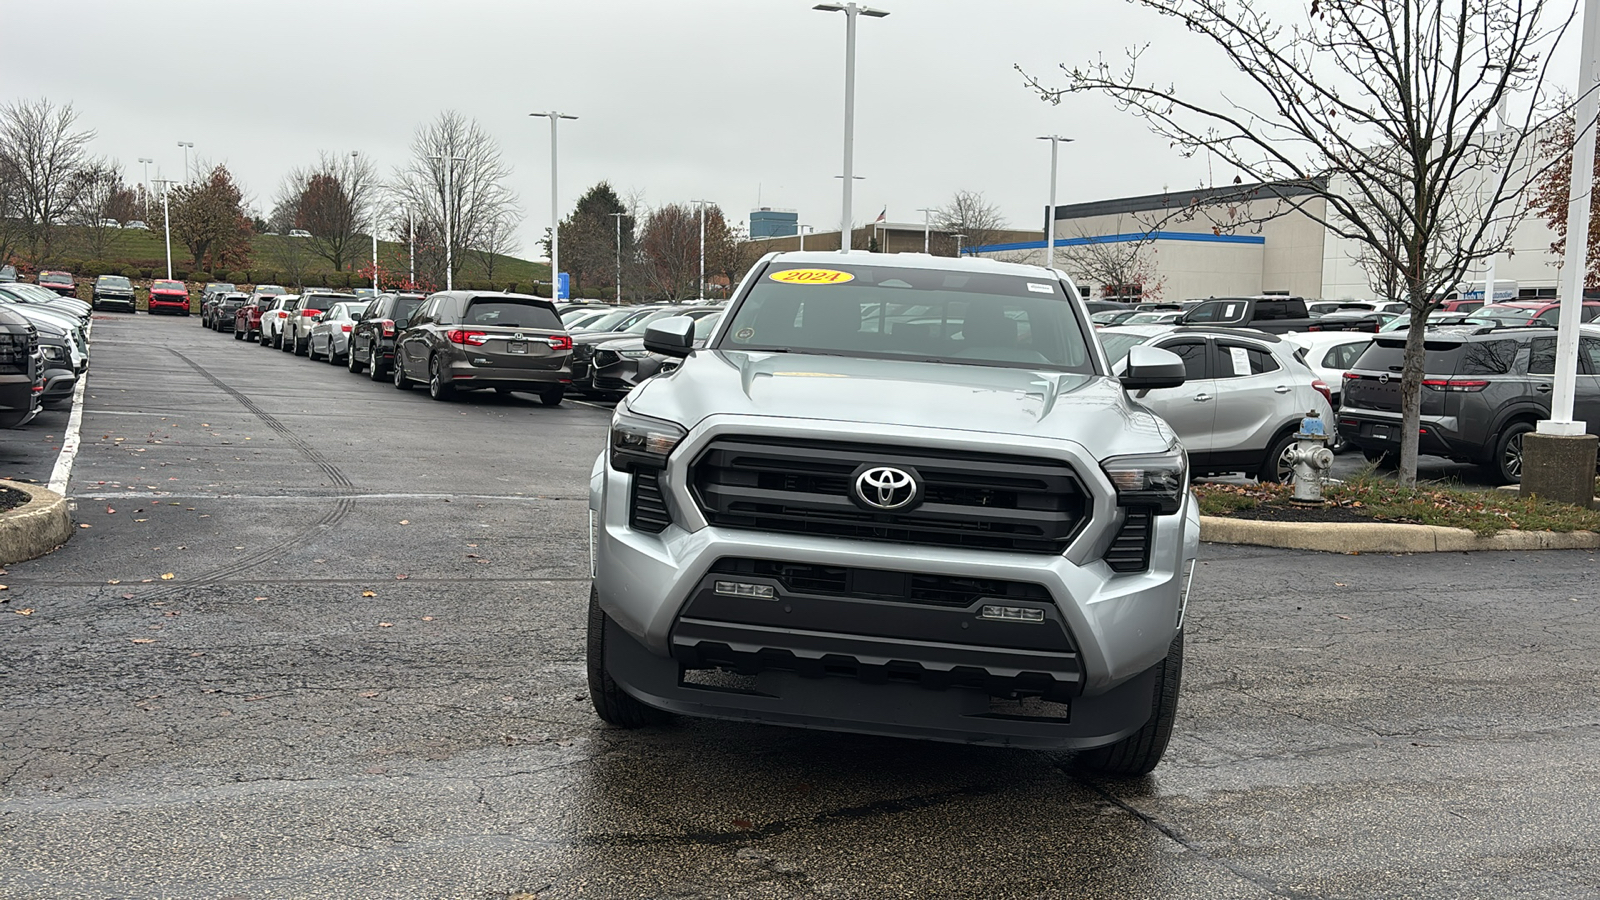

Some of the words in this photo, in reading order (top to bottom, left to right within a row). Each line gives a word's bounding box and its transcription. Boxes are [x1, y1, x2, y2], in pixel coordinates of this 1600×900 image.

[782, 271, 842, 282] 2024
[1493, 290, 1513, 299] utomotive
[1350, 384, 1397, 393] PATHFIN
